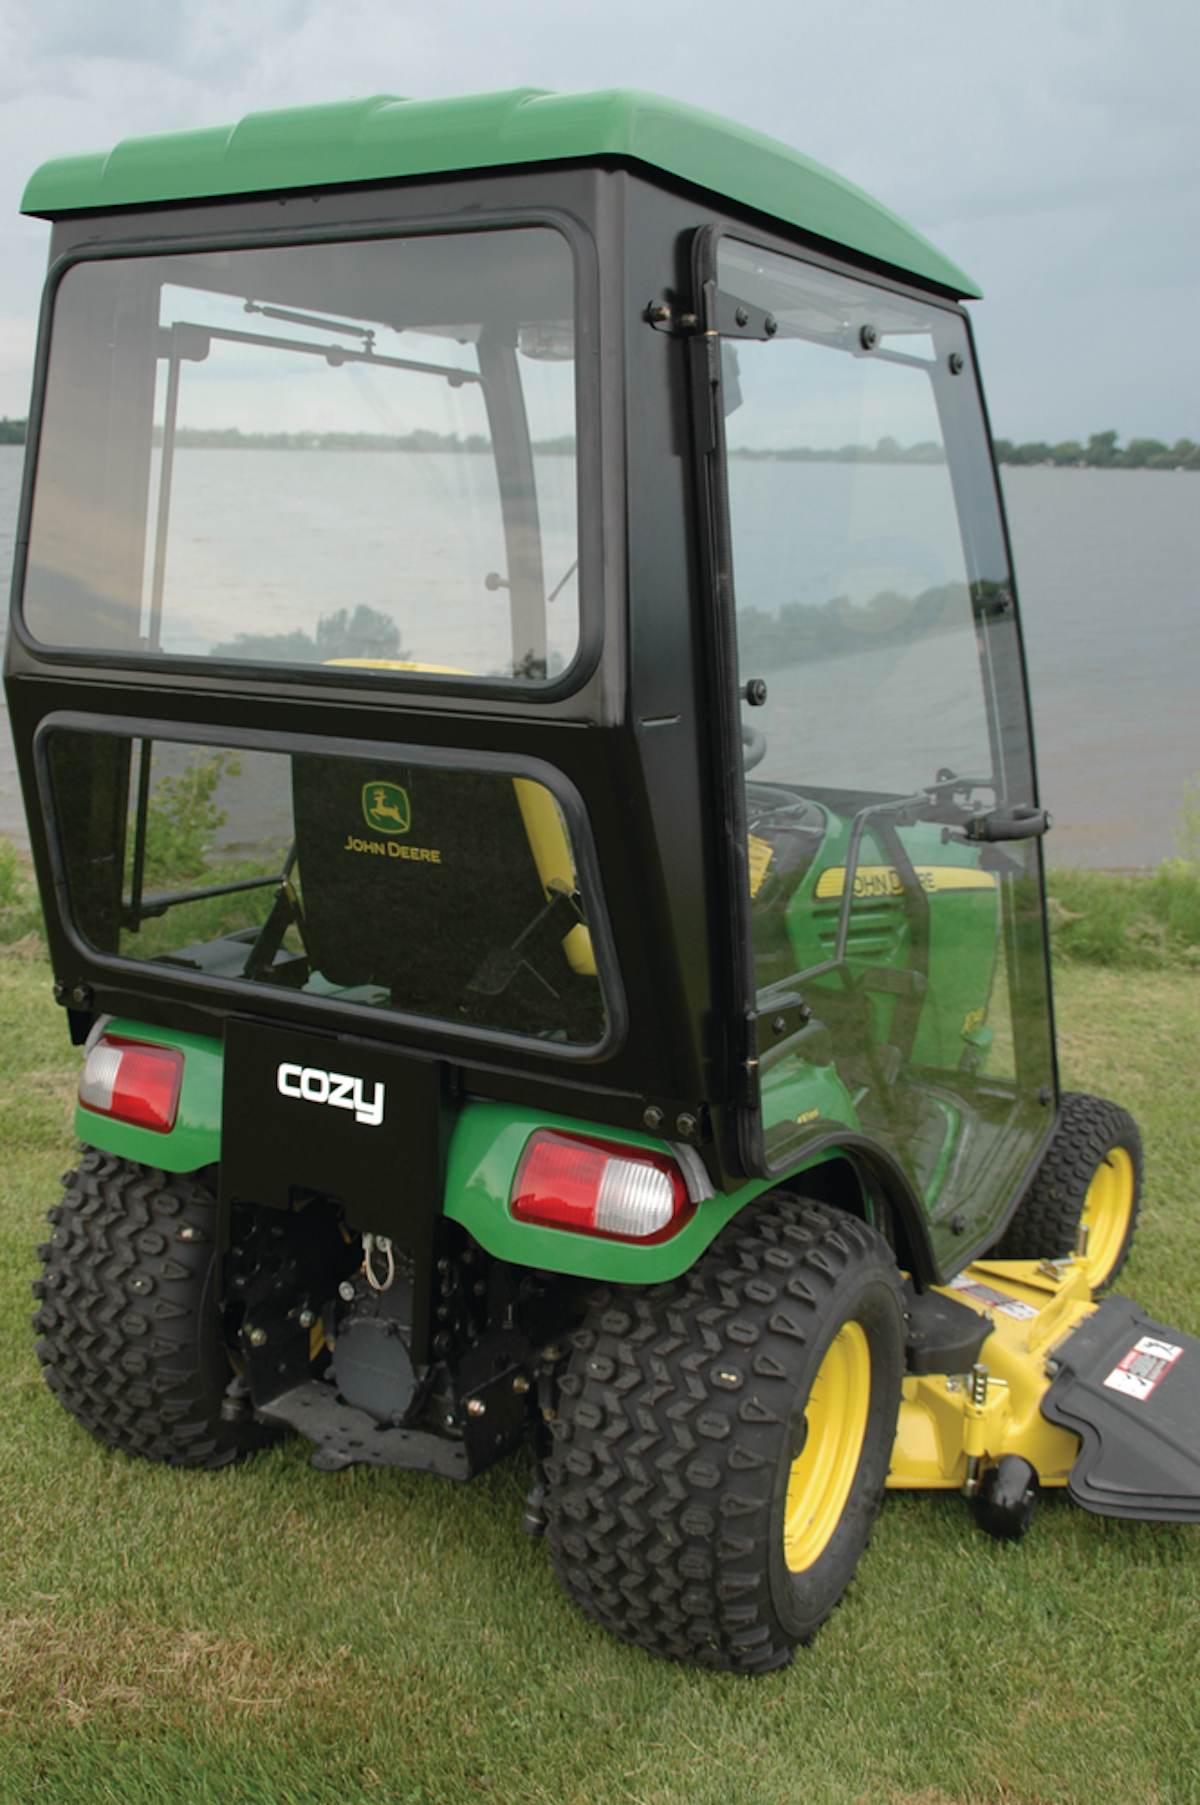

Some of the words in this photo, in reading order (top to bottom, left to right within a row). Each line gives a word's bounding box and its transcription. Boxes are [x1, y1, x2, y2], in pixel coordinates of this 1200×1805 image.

[344, 835, 386, 855] JOHN
[387, 841, 441, 864] DEERE
[853, 873, 887, 894] OHN
[889, 870, 935, 891] DRE
